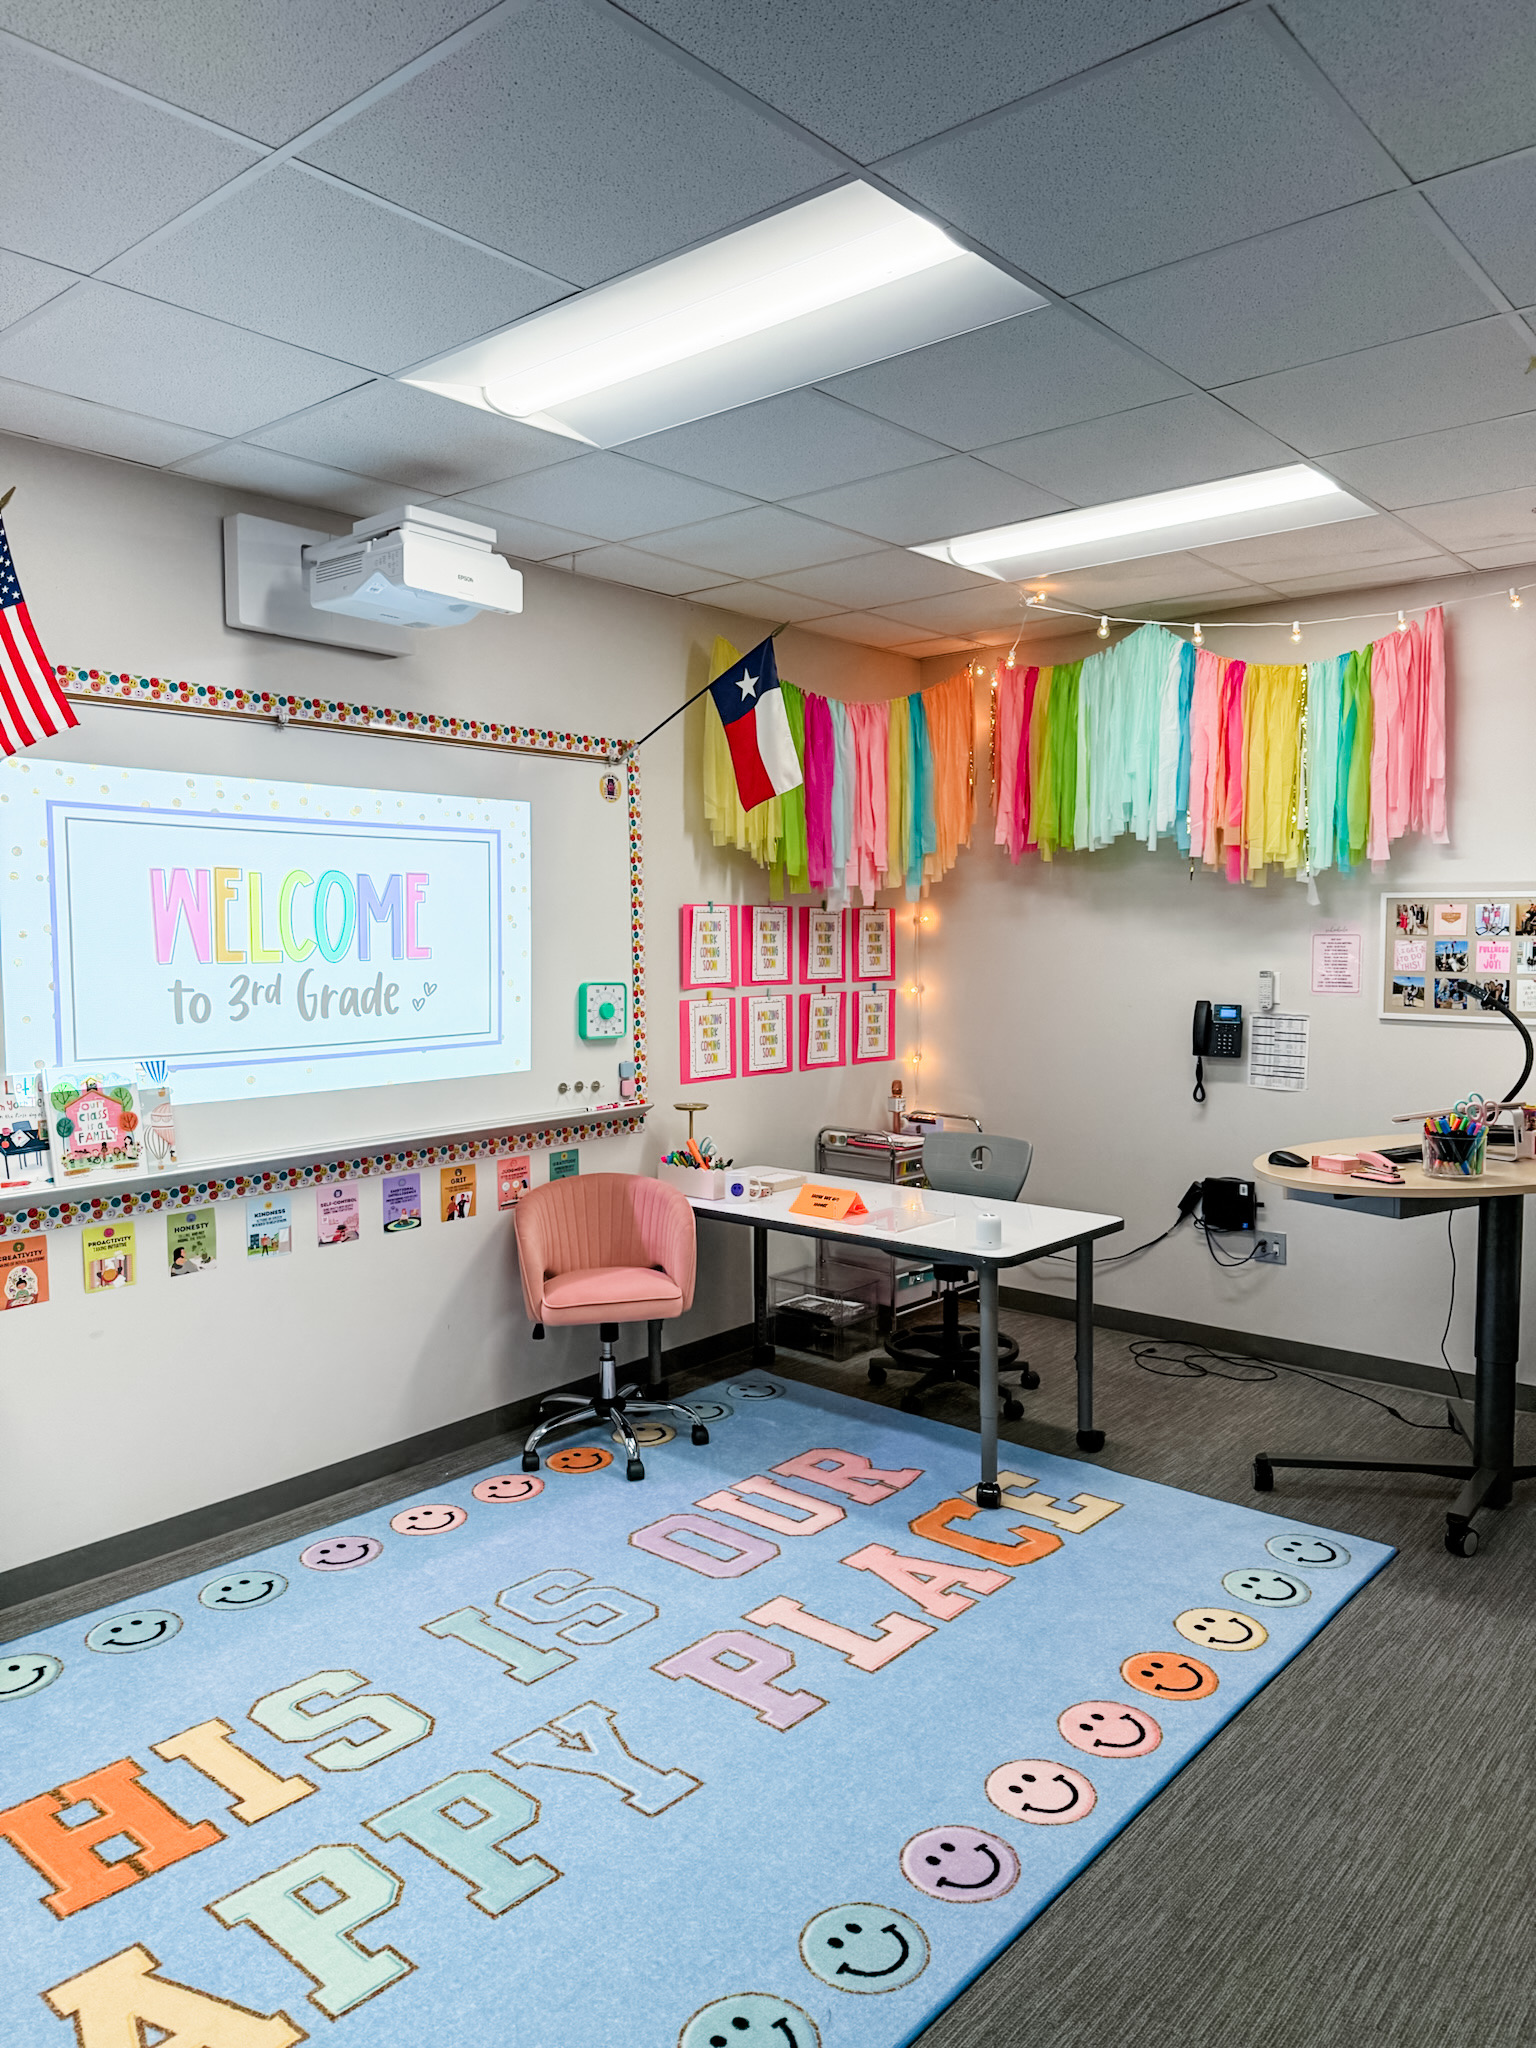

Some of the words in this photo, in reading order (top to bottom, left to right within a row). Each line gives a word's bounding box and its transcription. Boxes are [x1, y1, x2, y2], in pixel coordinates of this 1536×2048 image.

[457, 574, 474, 582] EPSON
[149, 867, 432, 965] WELCOME
[699, 921, 722, 932] AMAZING
[760, 921, 780, 931] AMAZING
[700, 946, 720, 958] COMING
[761, 946, 778, 956] COMING
[702, 959, 718, 971] SOON
[763, 958, 776, 969] SOON
[1401, 962, 1420, 971] THIS!
[1483, 960, 1501, 970] JOY!
[168, 979, 212, 1025] to
[227, 972, 283, 1023] 3rd
[297, 967, 400, 1023] Grade
[698, 1013, 722, 1026] AMAZING
[758, 1009, 779, 1021] AMAZING
[701, 1039, 720, 1051] COMING
[760, 1034, 778, 1046] COMING
[762, 1047, 776, 1058] SOON
[704, 1053, 718, 1065] SOON
[79, 1129, 117, 1144] FAMILY
[501, 1166, 527, 1175] JUDGMENT
[450, 1176, 467, 1185] GRIT
[320, 1197, 357, 1208] SELF-CONTROL
[254, 1208, 286, 1218] KINDNESS
[174, 1222, 209, 1233] HONESTY
[88, 1235, 132, 1247] PROACTIVITY
[420, 1567, 660, 1686] IS
[627, 1447, 926, 1580] OUR
[649, 1470, 1125, 1733] PLACE
